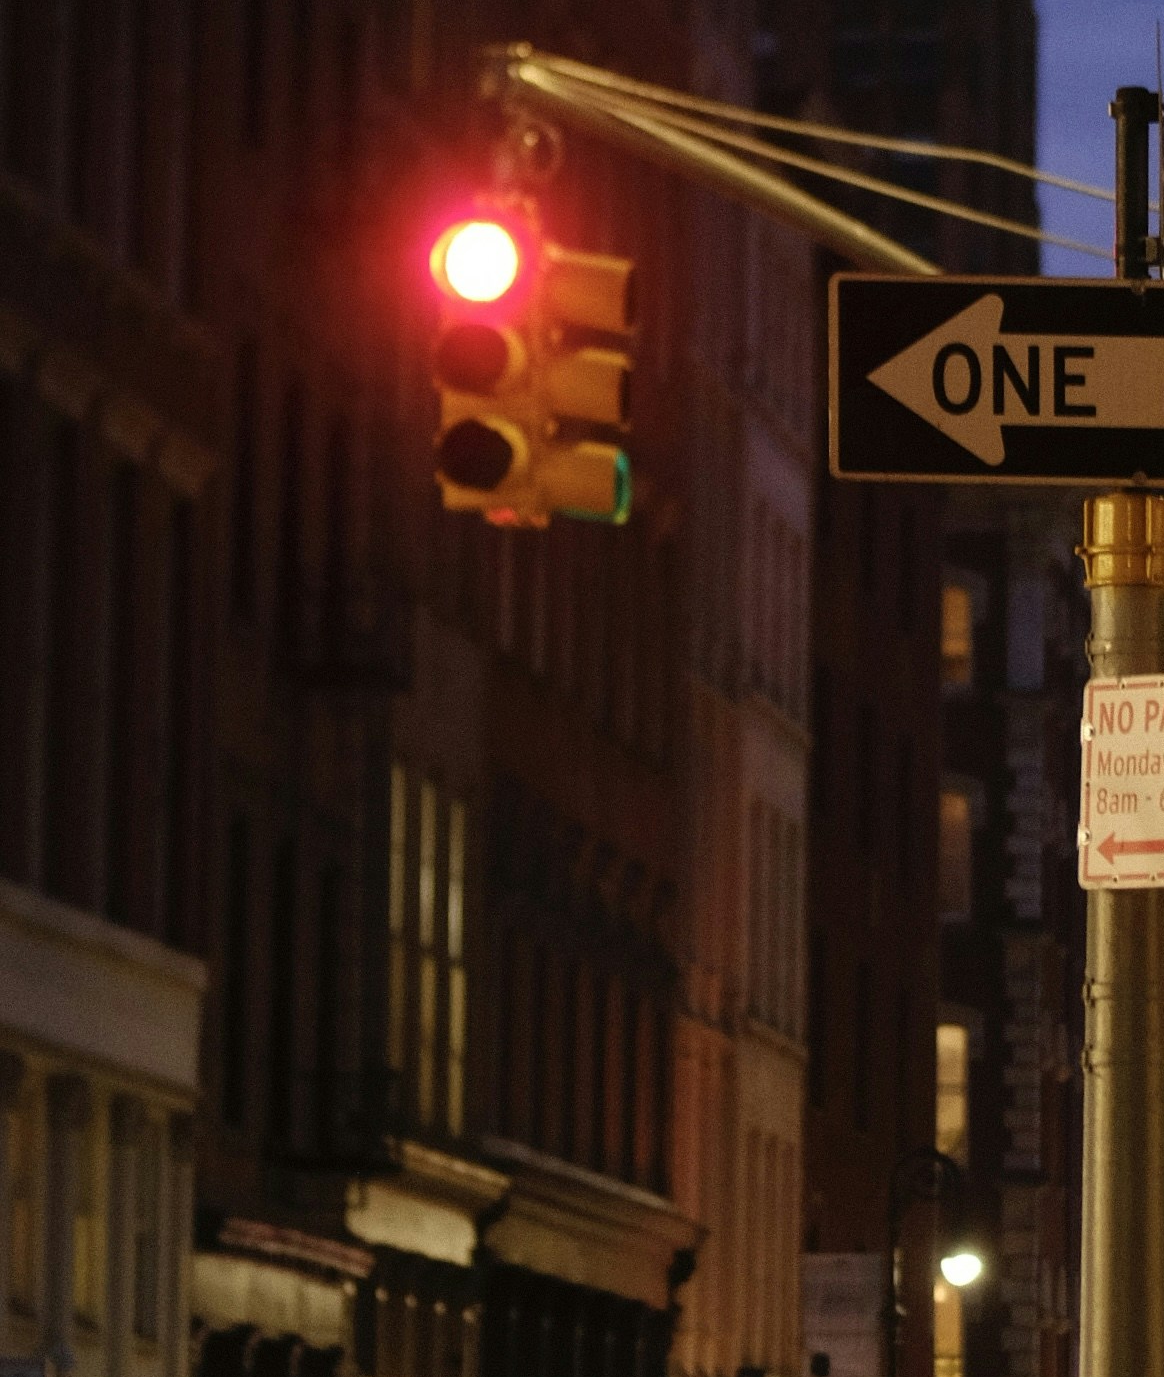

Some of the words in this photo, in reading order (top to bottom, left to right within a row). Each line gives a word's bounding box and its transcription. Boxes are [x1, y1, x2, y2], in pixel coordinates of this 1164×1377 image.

[932, 342, 1097, 417] ONE
[1099, 700, 1134, 735] NO
[1096, 787, 1138, 815] 8am
